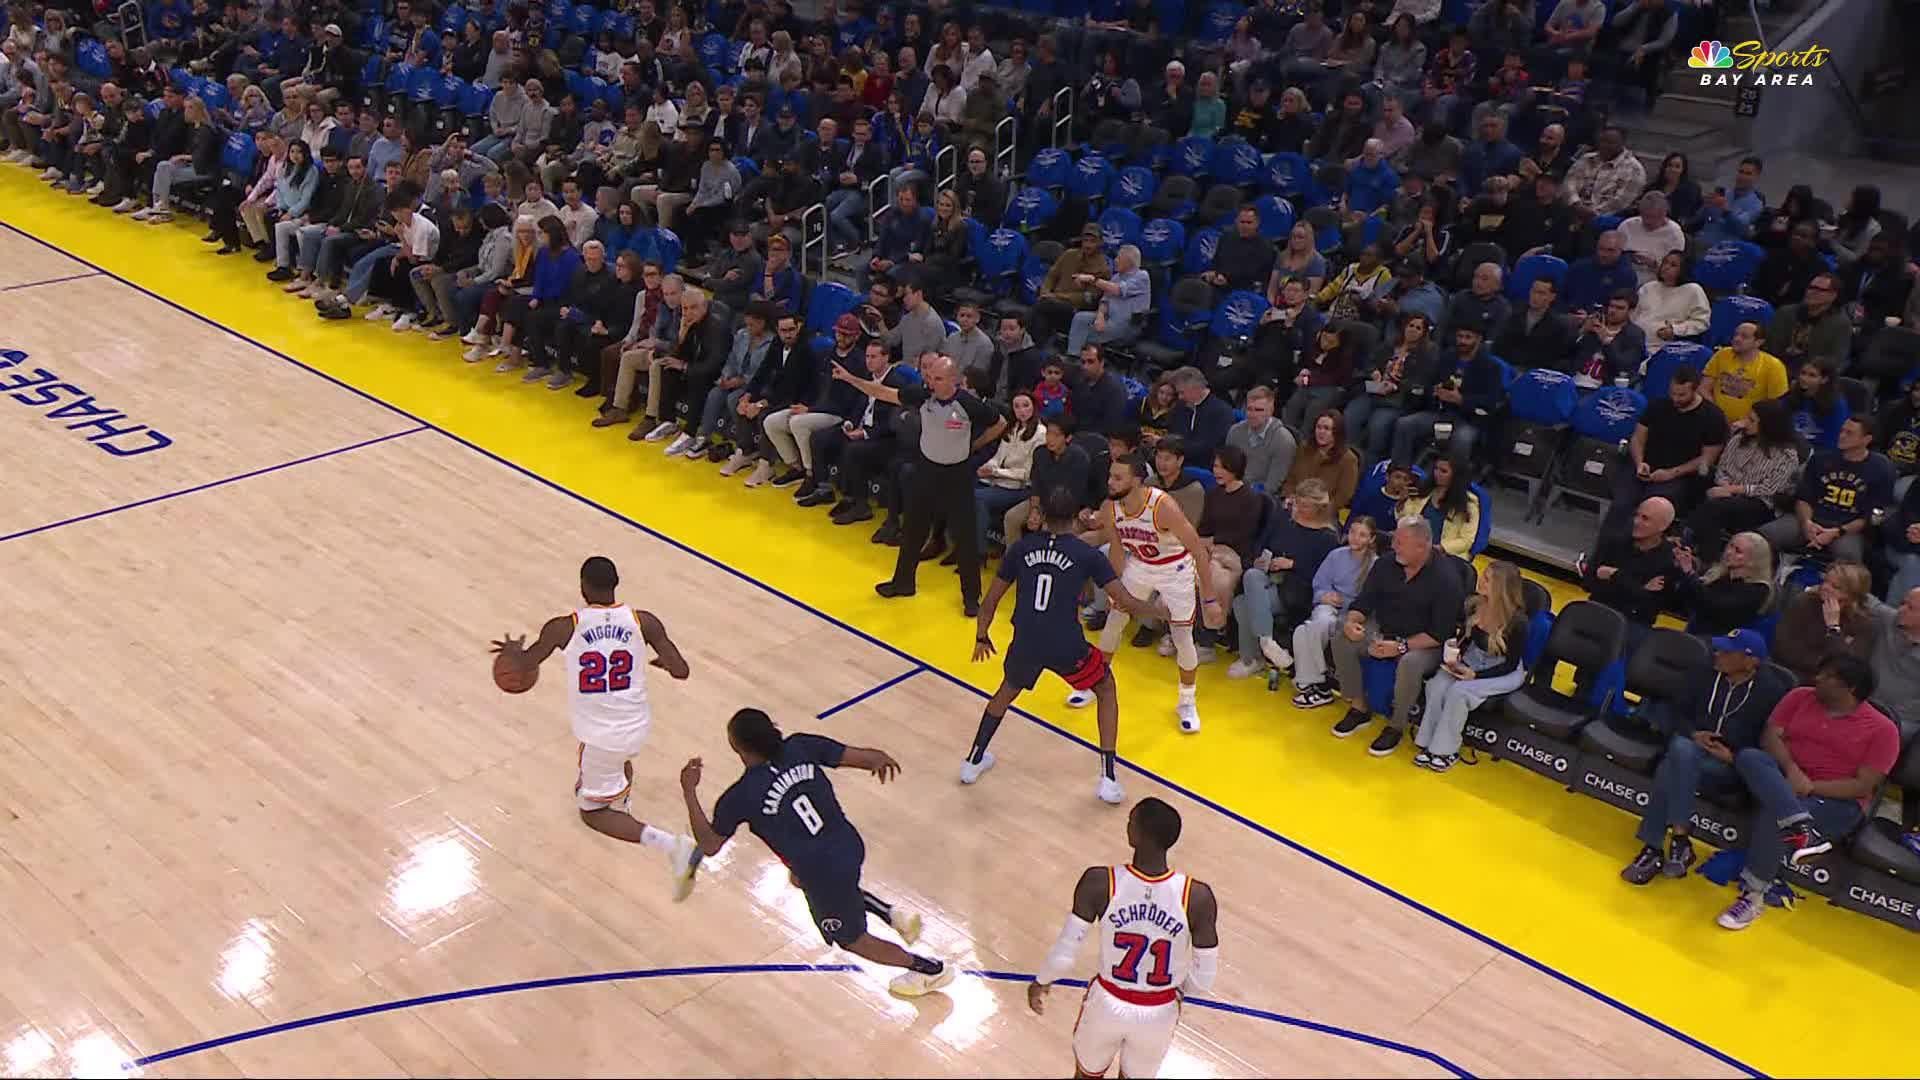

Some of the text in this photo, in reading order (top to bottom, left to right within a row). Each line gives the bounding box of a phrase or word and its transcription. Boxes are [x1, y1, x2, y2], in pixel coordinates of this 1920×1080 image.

[0, 368, 173, 456] CHASE
[1824, 484, 1857, 510] 30
[1034, 573, 1053, 612] 0
[581, 624, 633, 645] WIGGINS
[579, 650, 633, 694] 22
[1506, 737, 1554, 767] CHASE
[1585, 772, 1636, 801] CHASE
[791, 794, 824, 836] 8
[1689, 813, 1723, 835] ASE
[1849, 885, 1914, 916] CHASE
[1108, 902, 1184, 937] SCHRÖDER
[1112, 931, 1172, 987] 71
